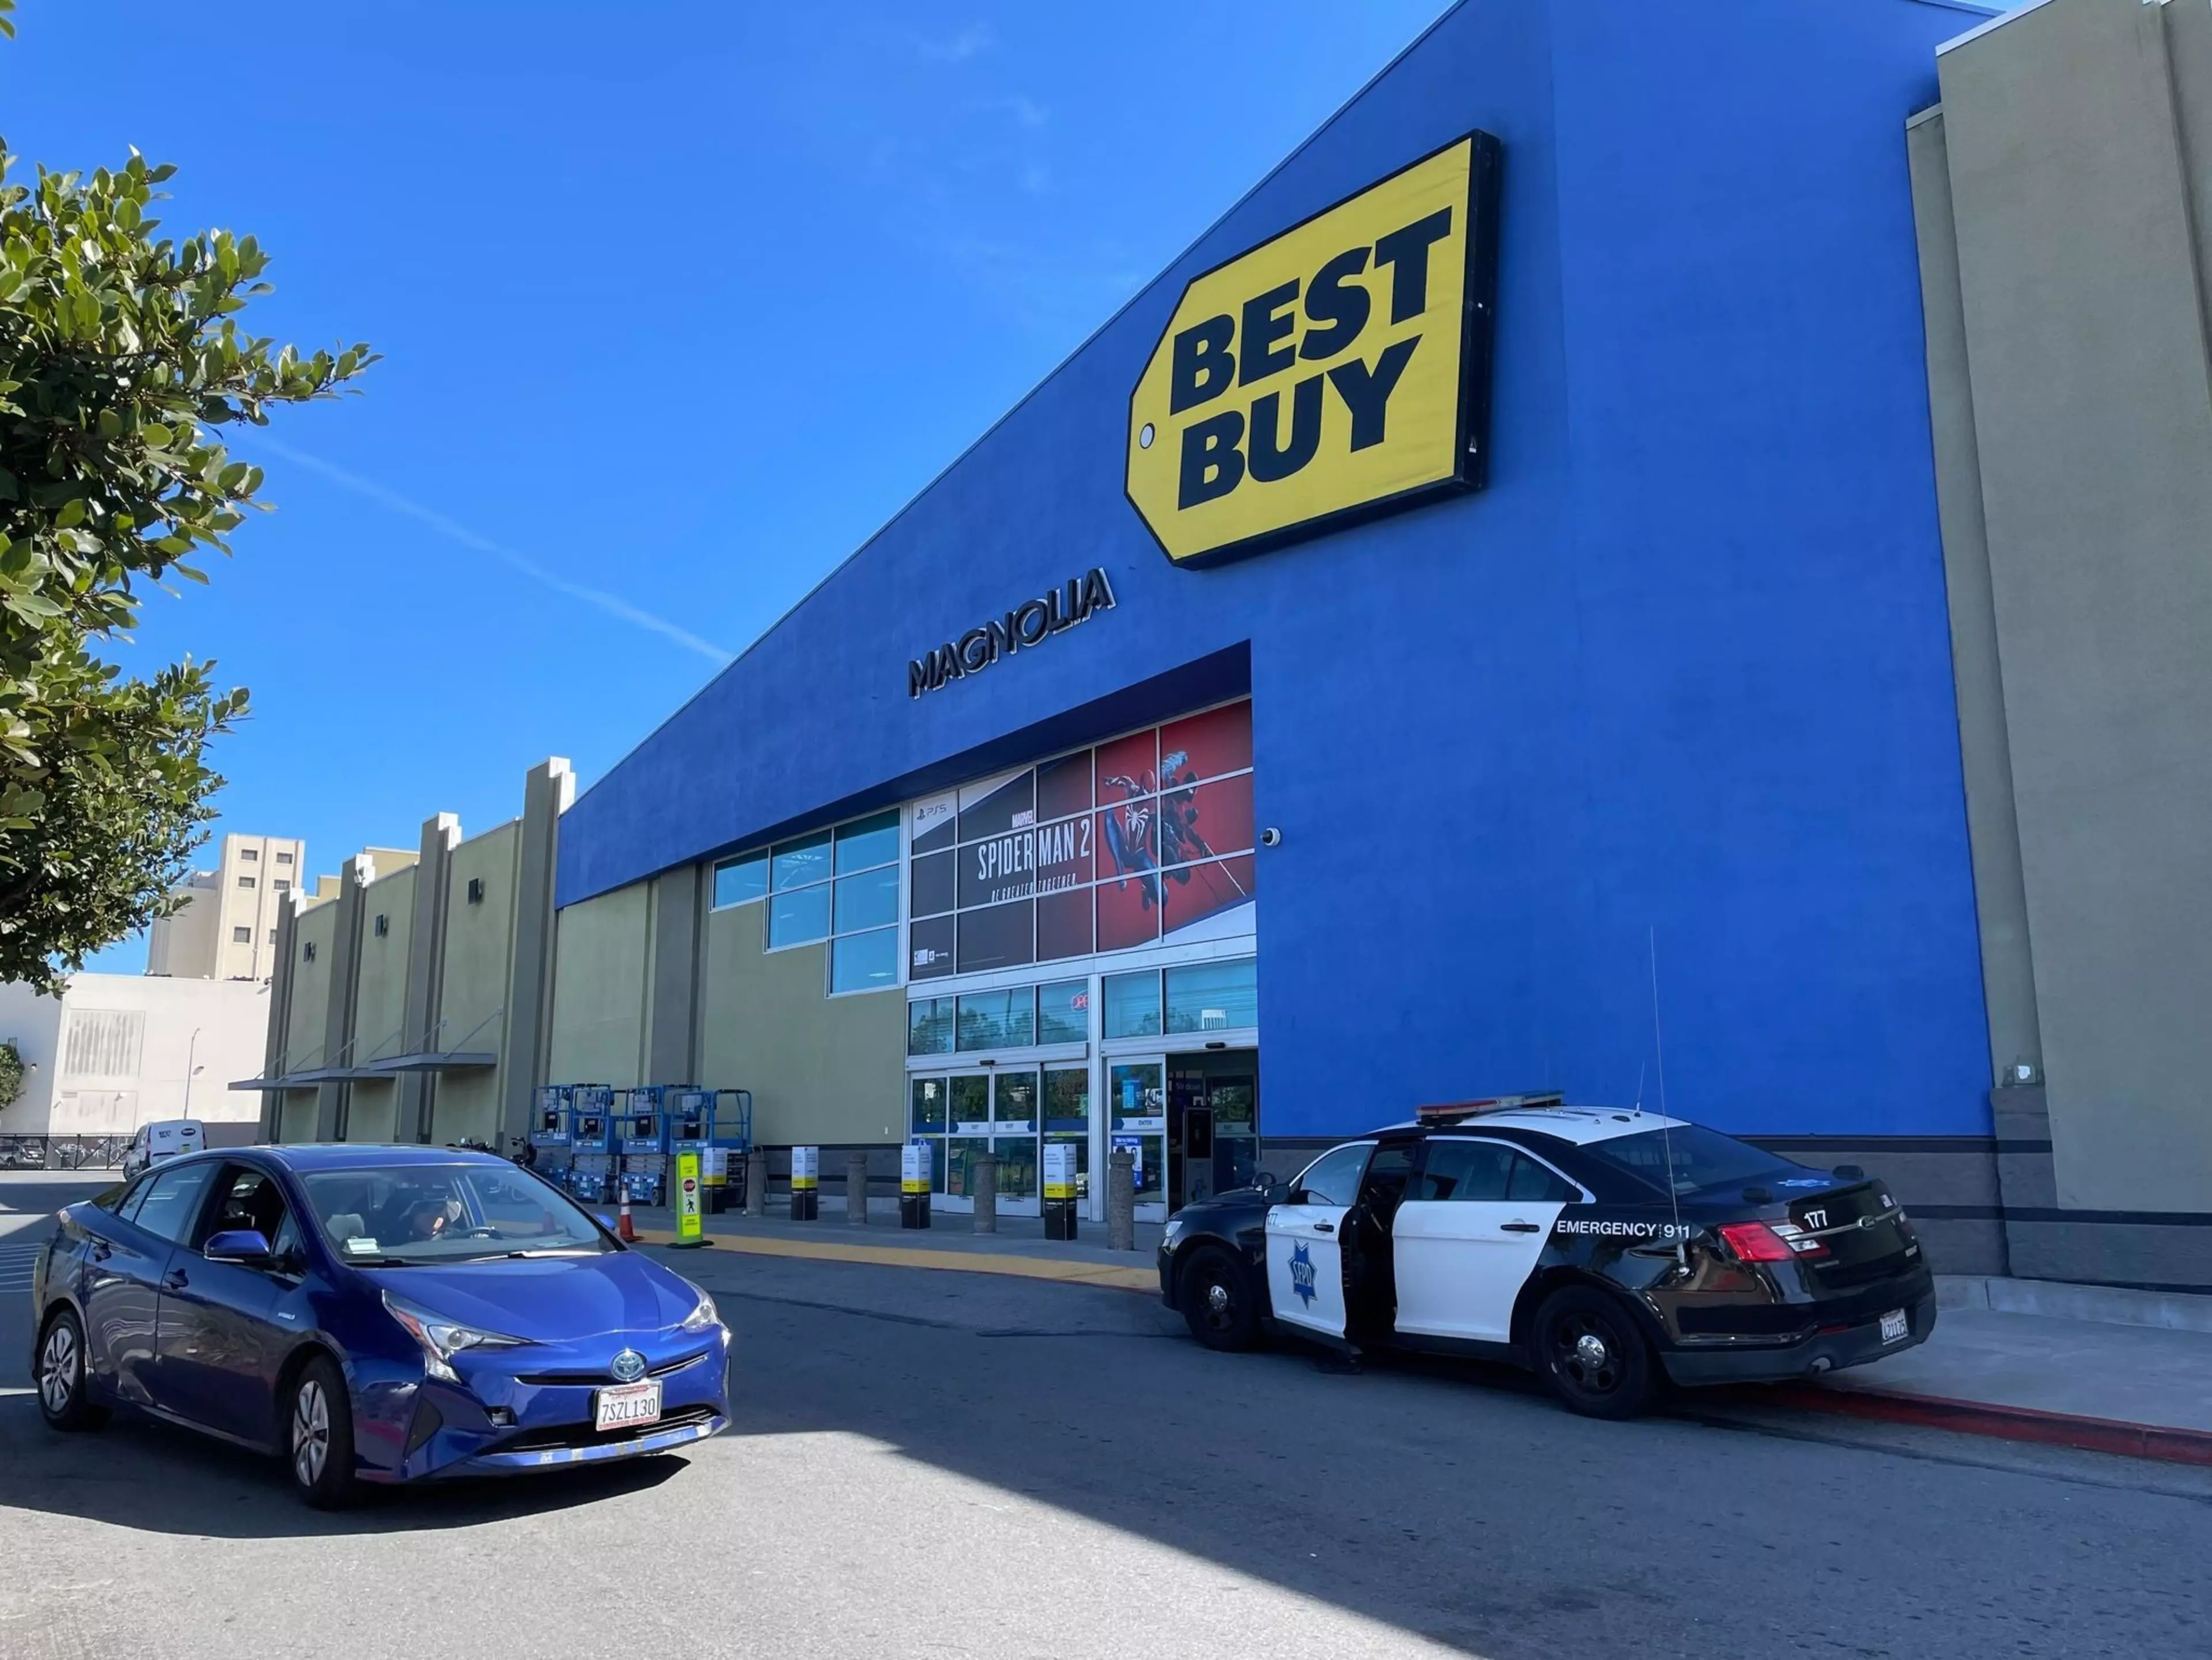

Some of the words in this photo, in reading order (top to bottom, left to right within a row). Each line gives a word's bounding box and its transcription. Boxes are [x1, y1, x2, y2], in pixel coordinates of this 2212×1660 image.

[1170, 205, 1452, 415] BEST
[1178, 334, 1423, 511] BUY
[909, 567, 1116, 699] MAGNOLIA
[926, 803, 947, 816] PS5
[1012, 810, 1034, 828] MARVEL
[1081, 819, 1090, 857] 2
[991, 890, 999, 902] BE
[1002, 882, 1033, 900] GREATER
[1557, 1220, 1657, 1237] EMERGENCY
[1664, 1224, 1690, 1239] 911
[1804, 1210, 1828, 1228] 177
[1293, 1260, 1312, 1287] SFPD
[603, 1398, 656, 1423] 7SZL130
